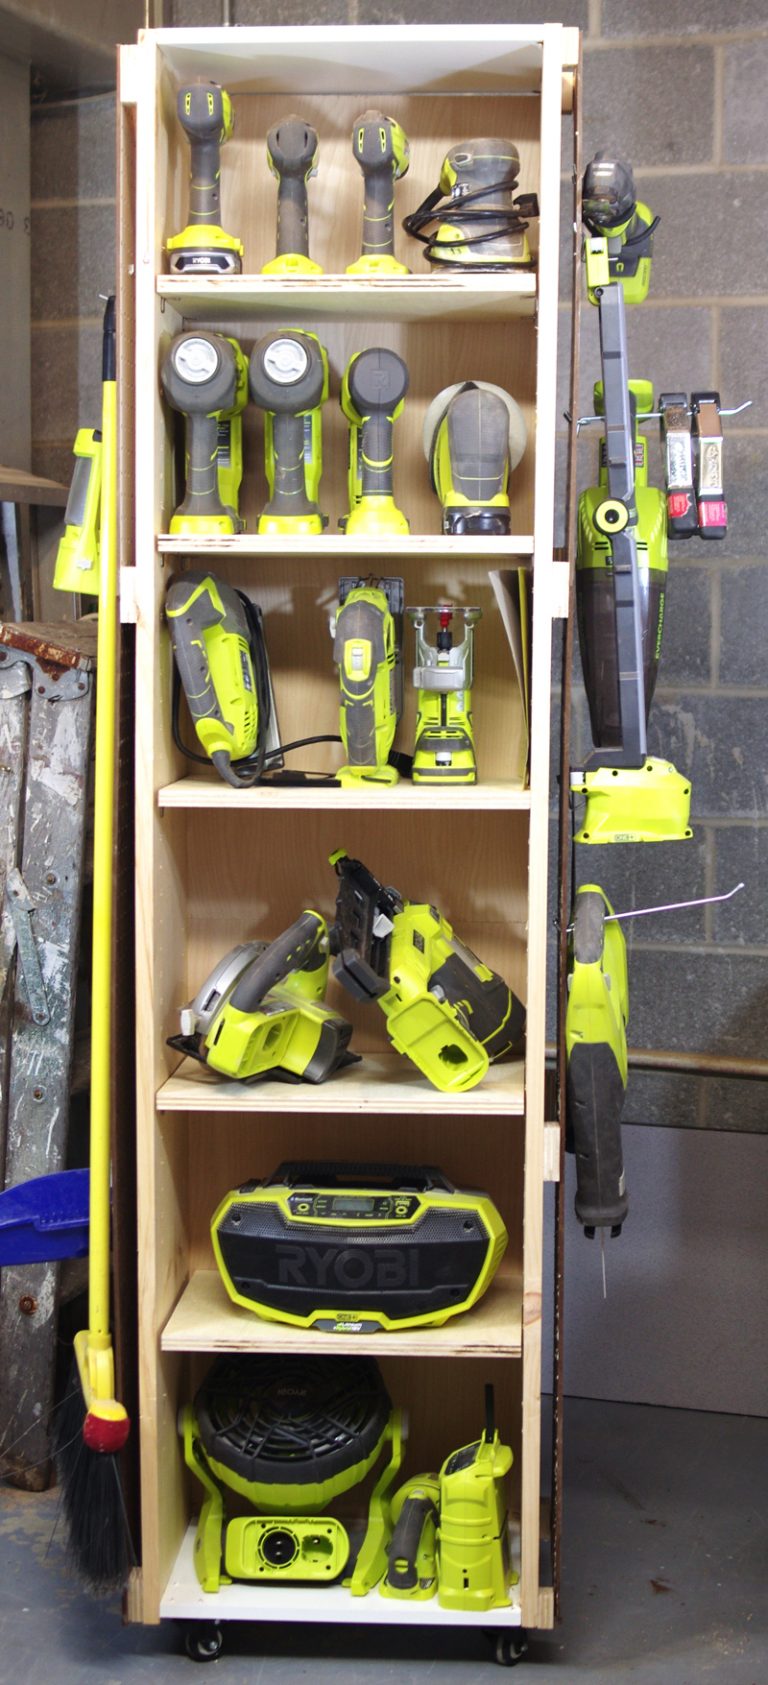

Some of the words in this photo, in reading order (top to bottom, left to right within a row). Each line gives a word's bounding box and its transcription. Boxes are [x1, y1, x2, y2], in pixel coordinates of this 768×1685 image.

[192, 256, 211, 264] RYOBI
[655, 592, 665, 660] EVERCHARGE
[275, 1244, 420, 1289] RYOBI
